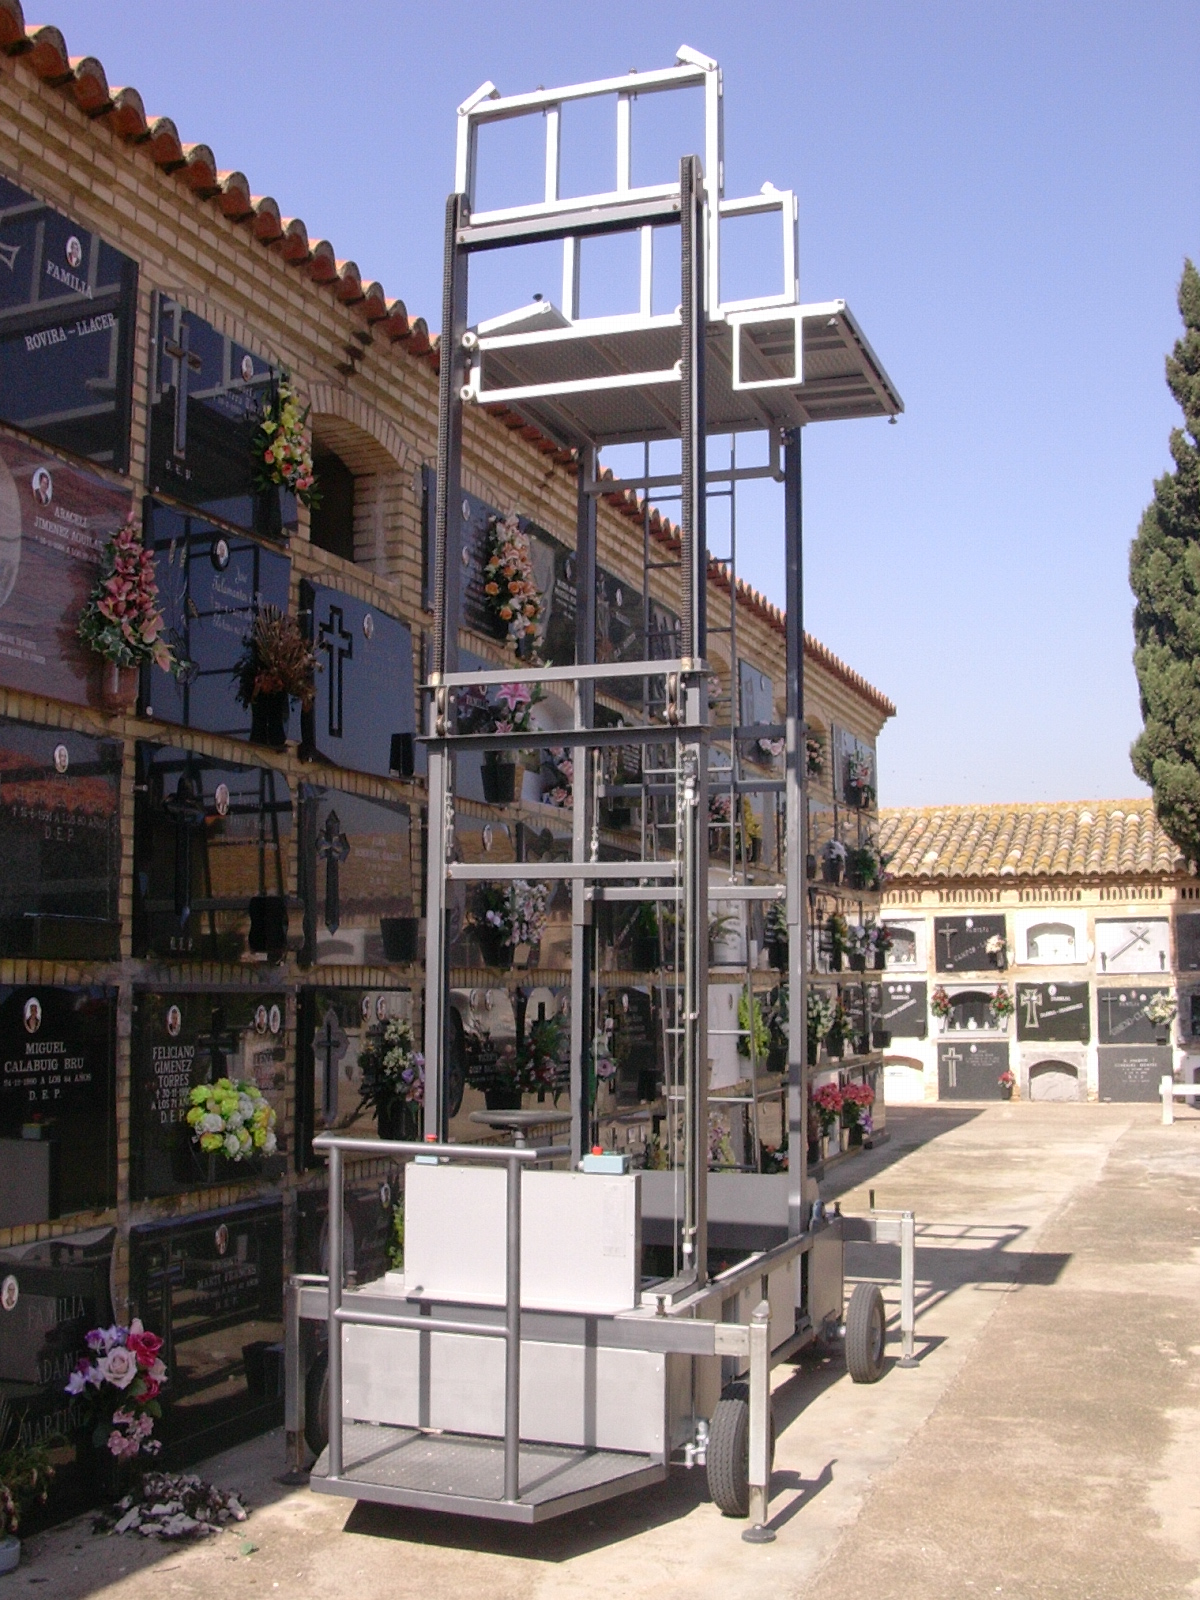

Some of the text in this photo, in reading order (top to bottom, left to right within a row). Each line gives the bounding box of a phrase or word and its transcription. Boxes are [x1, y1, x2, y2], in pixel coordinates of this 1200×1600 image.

[46, 260, 93, 300] FAMILIA
[24, 326, 68, 351] ROVIRA
[75, 312, 117, 336] LLACER
[25, 1041, 67, 1055] MIGUEL
[152, 1045, 195, 1060] FELICIANO
[4, 1057, 84, 1073] CALABUIG BRU
[154, 1059, 193, 1074] GIMENEZ
[48, 1075, 61, 1084] LOS
[158, 1073, 189, 1088] TORRES
[158, 1099, 169, 1110] LOS
